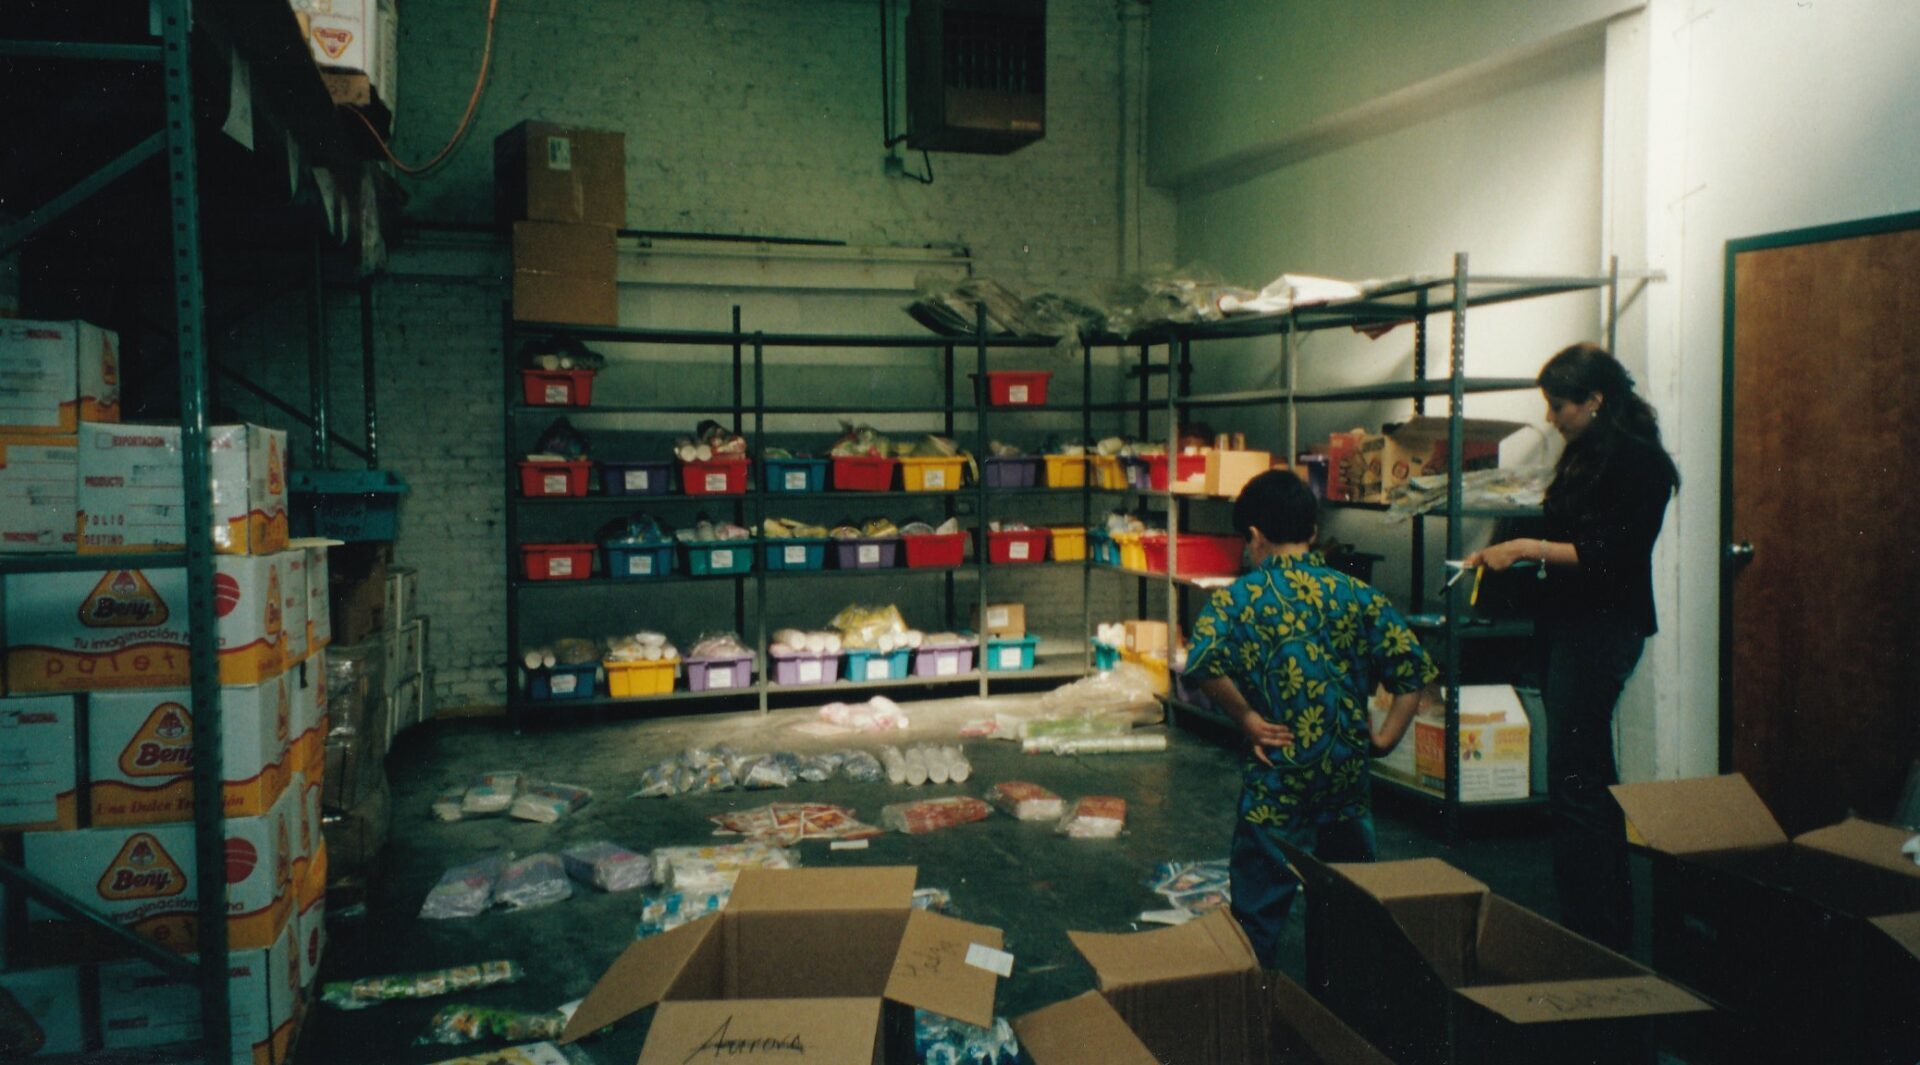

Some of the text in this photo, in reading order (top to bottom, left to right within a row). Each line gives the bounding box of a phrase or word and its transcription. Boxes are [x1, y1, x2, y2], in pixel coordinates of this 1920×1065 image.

[94, 597, 153, 620] Beny
[46, 651, 192, 678] palet
[112, 869, 171, 891] Beny
